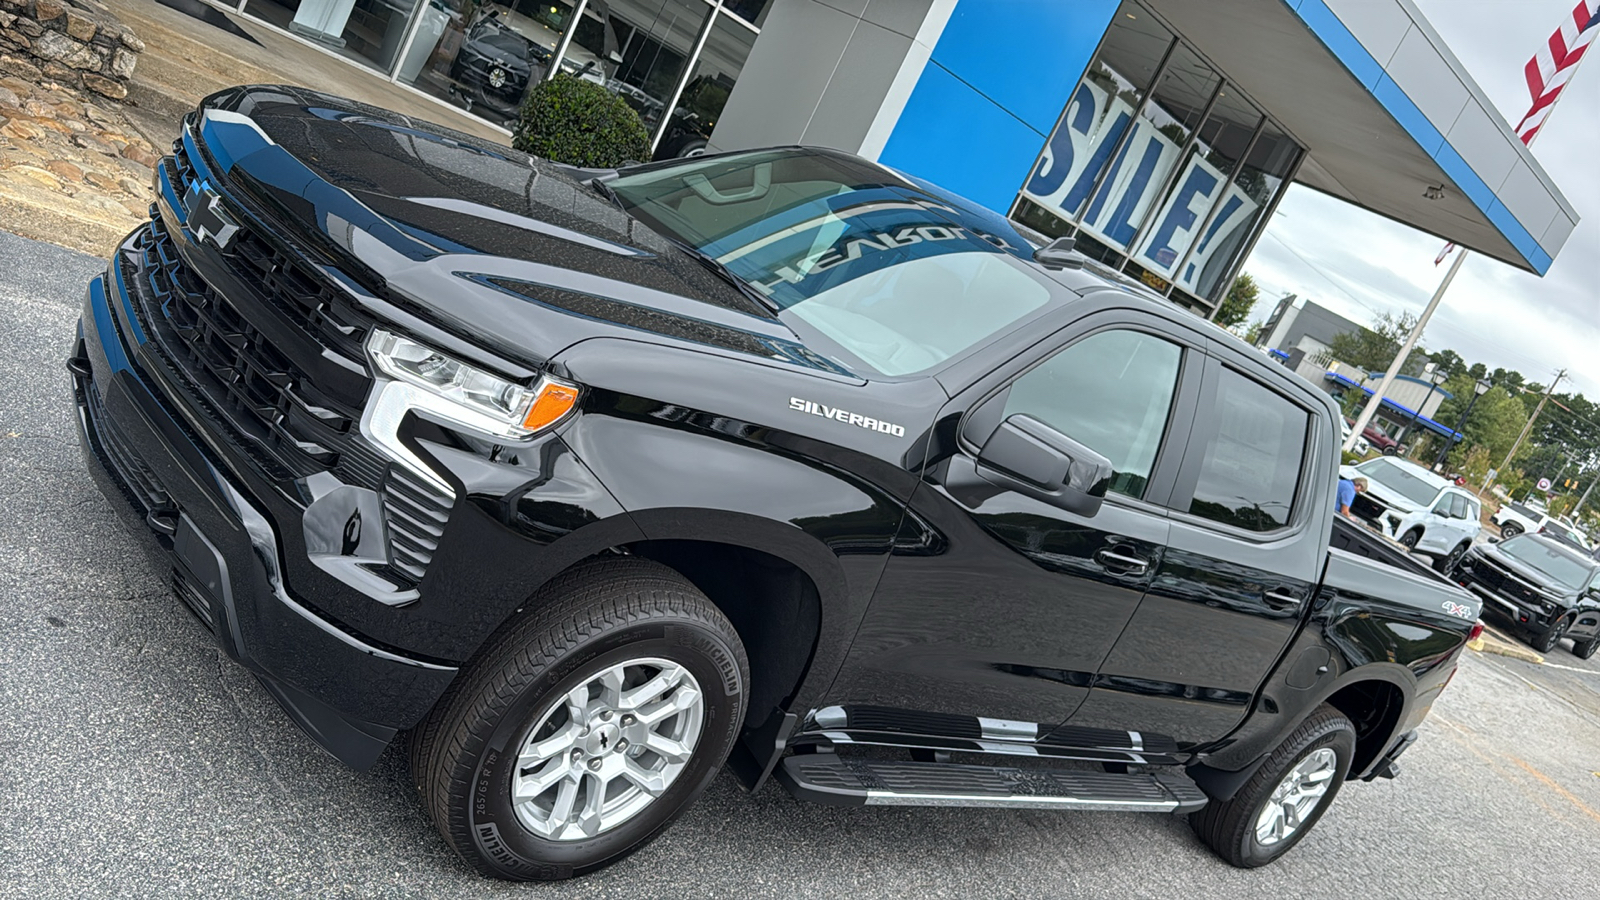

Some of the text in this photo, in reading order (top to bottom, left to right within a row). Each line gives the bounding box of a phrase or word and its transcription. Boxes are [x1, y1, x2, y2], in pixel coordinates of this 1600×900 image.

[1026, 82, 1245, 285] SALE!
[788, 396, 906, 438] SILVERADO
[695, 637, 738, 693] MICHELIN
[724, 702, 739, 743] PRIMACY
[477, 780, 489, 816] 265/65
[480, 826, 537, 876] MICHELIN
